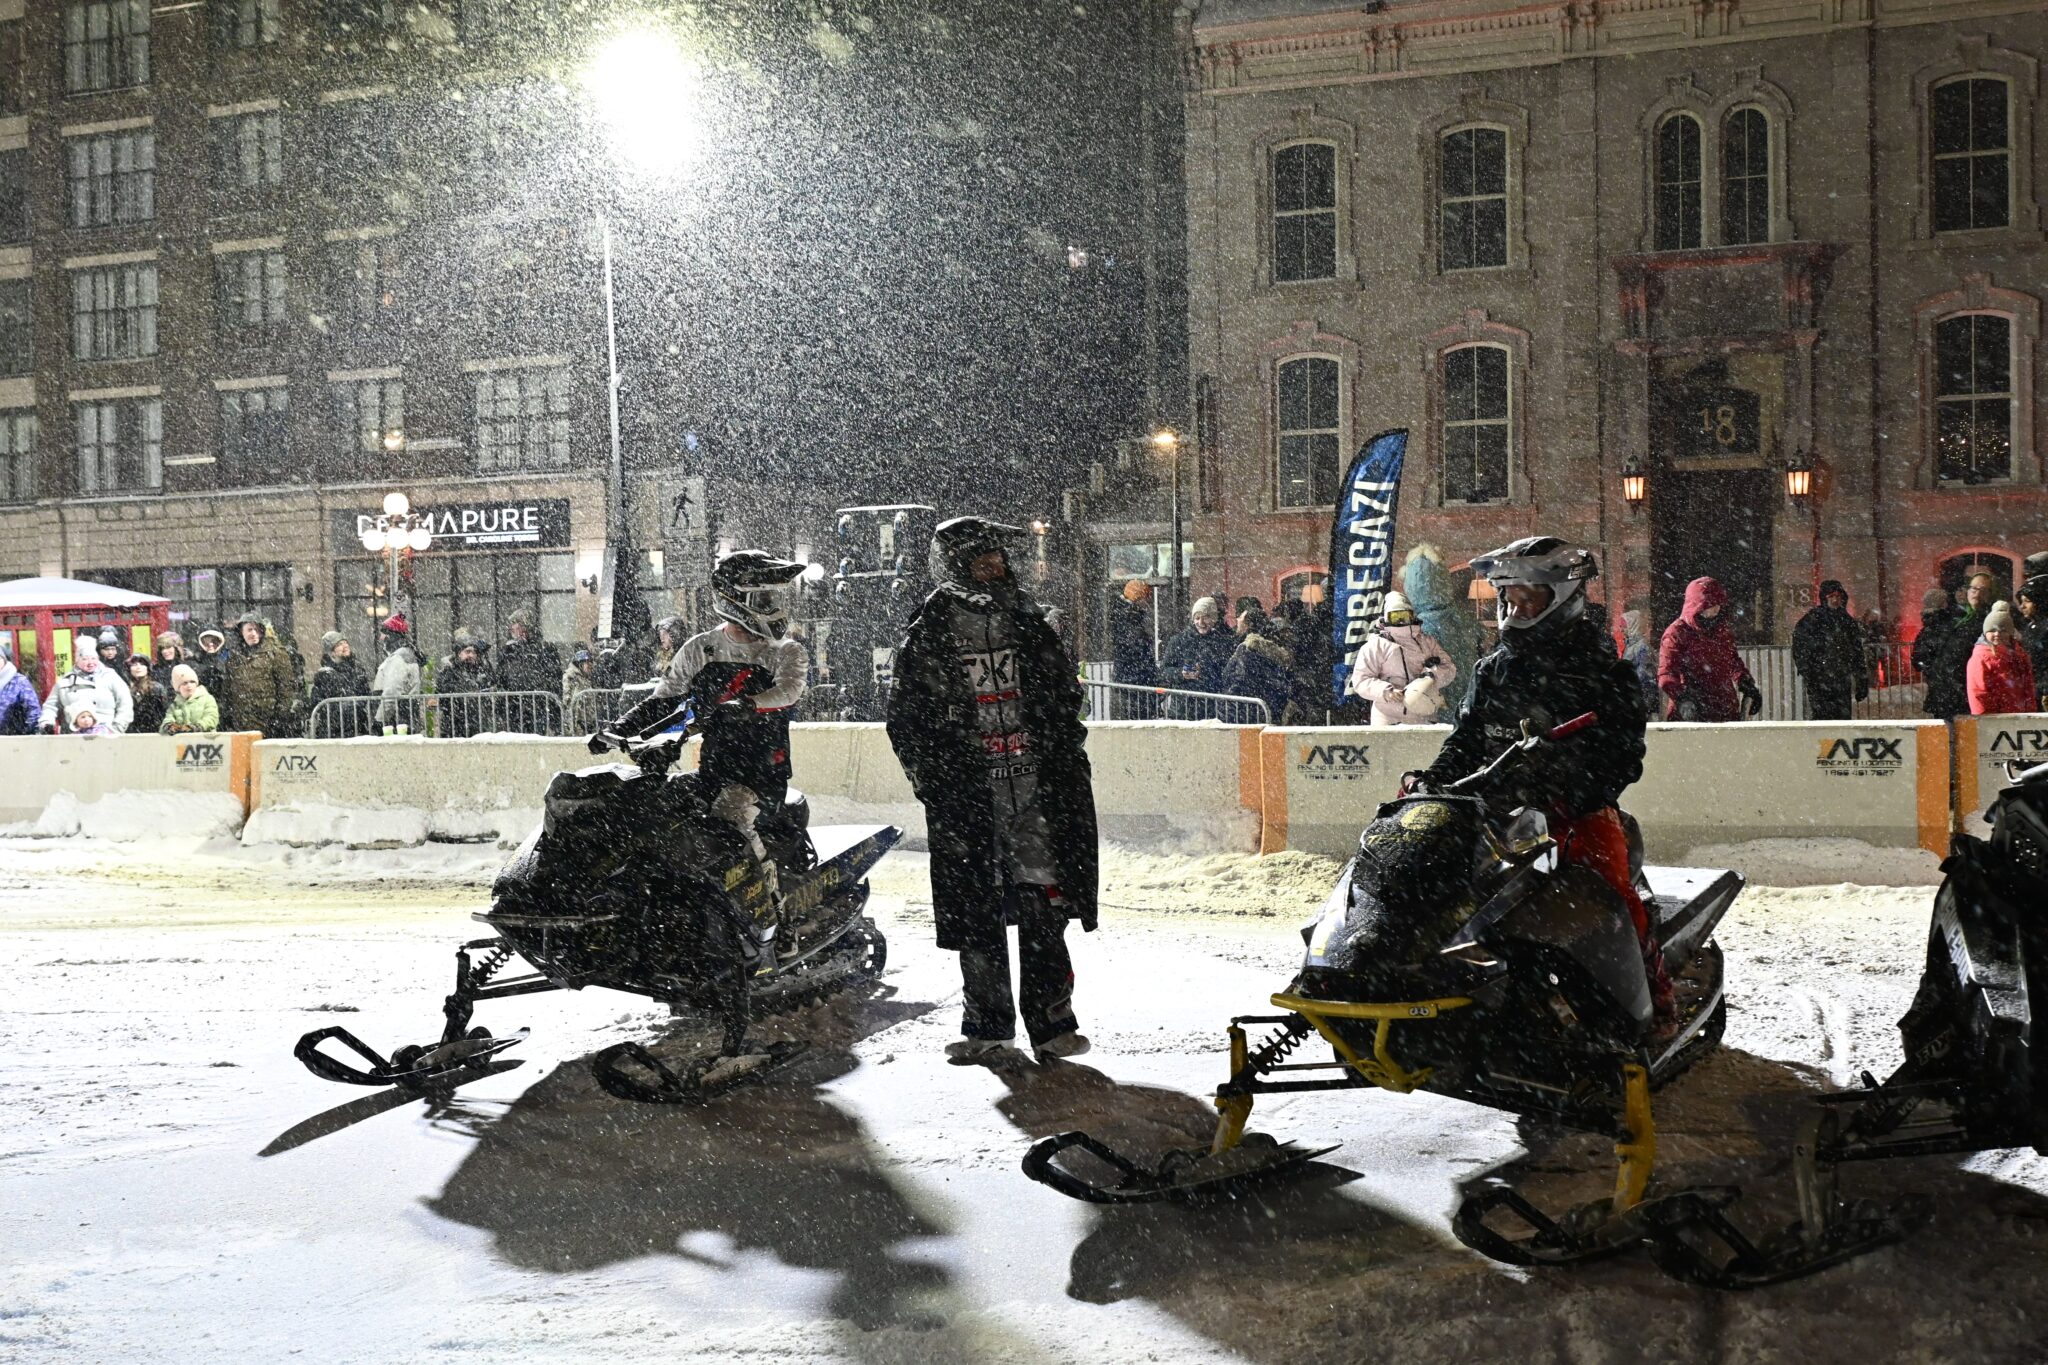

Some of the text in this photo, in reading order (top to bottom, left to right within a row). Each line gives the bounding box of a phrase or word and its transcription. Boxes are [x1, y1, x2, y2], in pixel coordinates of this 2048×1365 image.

[1700, 405, 1736, 446] 18
[357, 508, 539, 536] DEMAPURE
[1344, 481, 1395, 696] RBEGAZI
[182, 744, 223, 761] ARX
[1306, 745, 1370, 765] ARX
[1827, 737, 1903, 760] ARX
[275, 755, 318, 771] ARX
